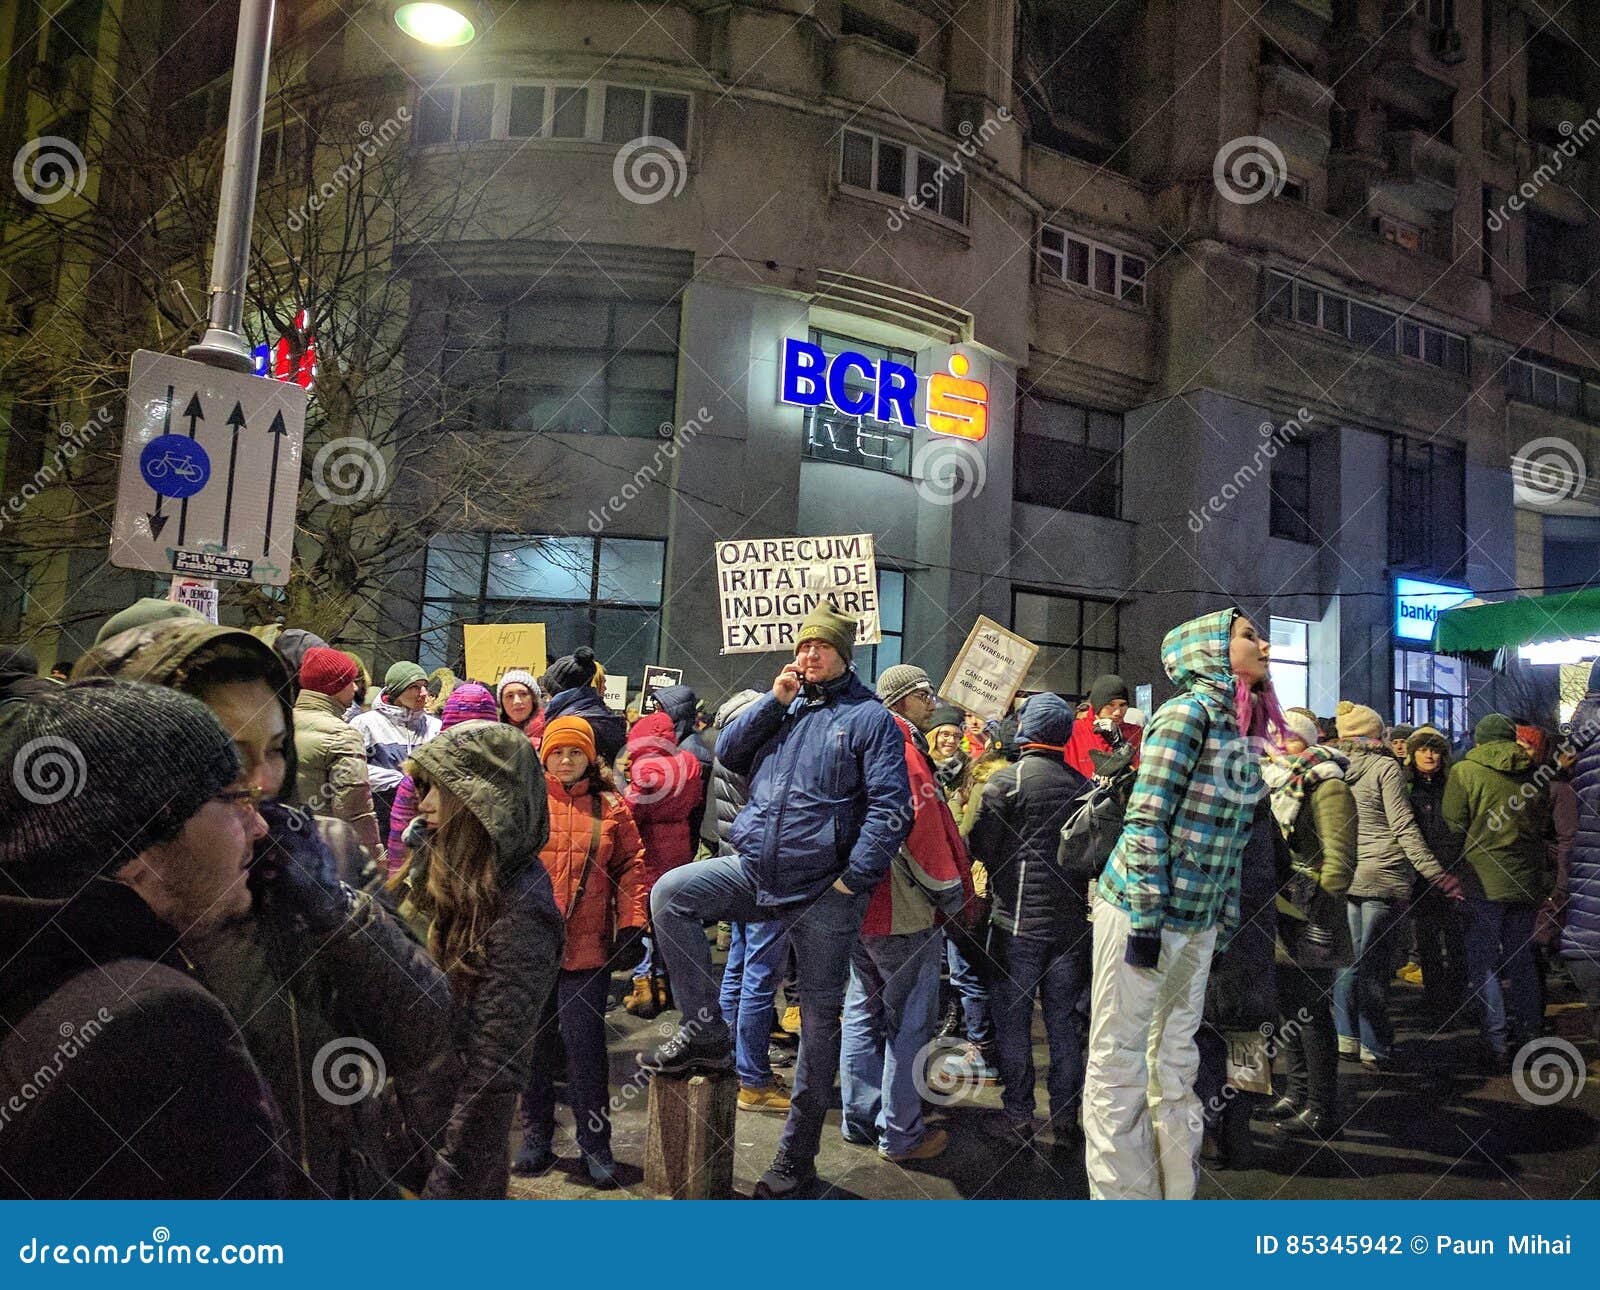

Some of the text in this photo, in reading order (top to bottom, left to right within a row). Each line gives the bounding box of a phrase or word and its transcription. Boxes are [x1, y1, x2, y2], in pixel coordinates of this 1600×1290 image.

[781, 336, 918, 429] BCR
[719, 537, 861, 564] OARECUM
[721, 564, 868, 592] IRITAT DE
